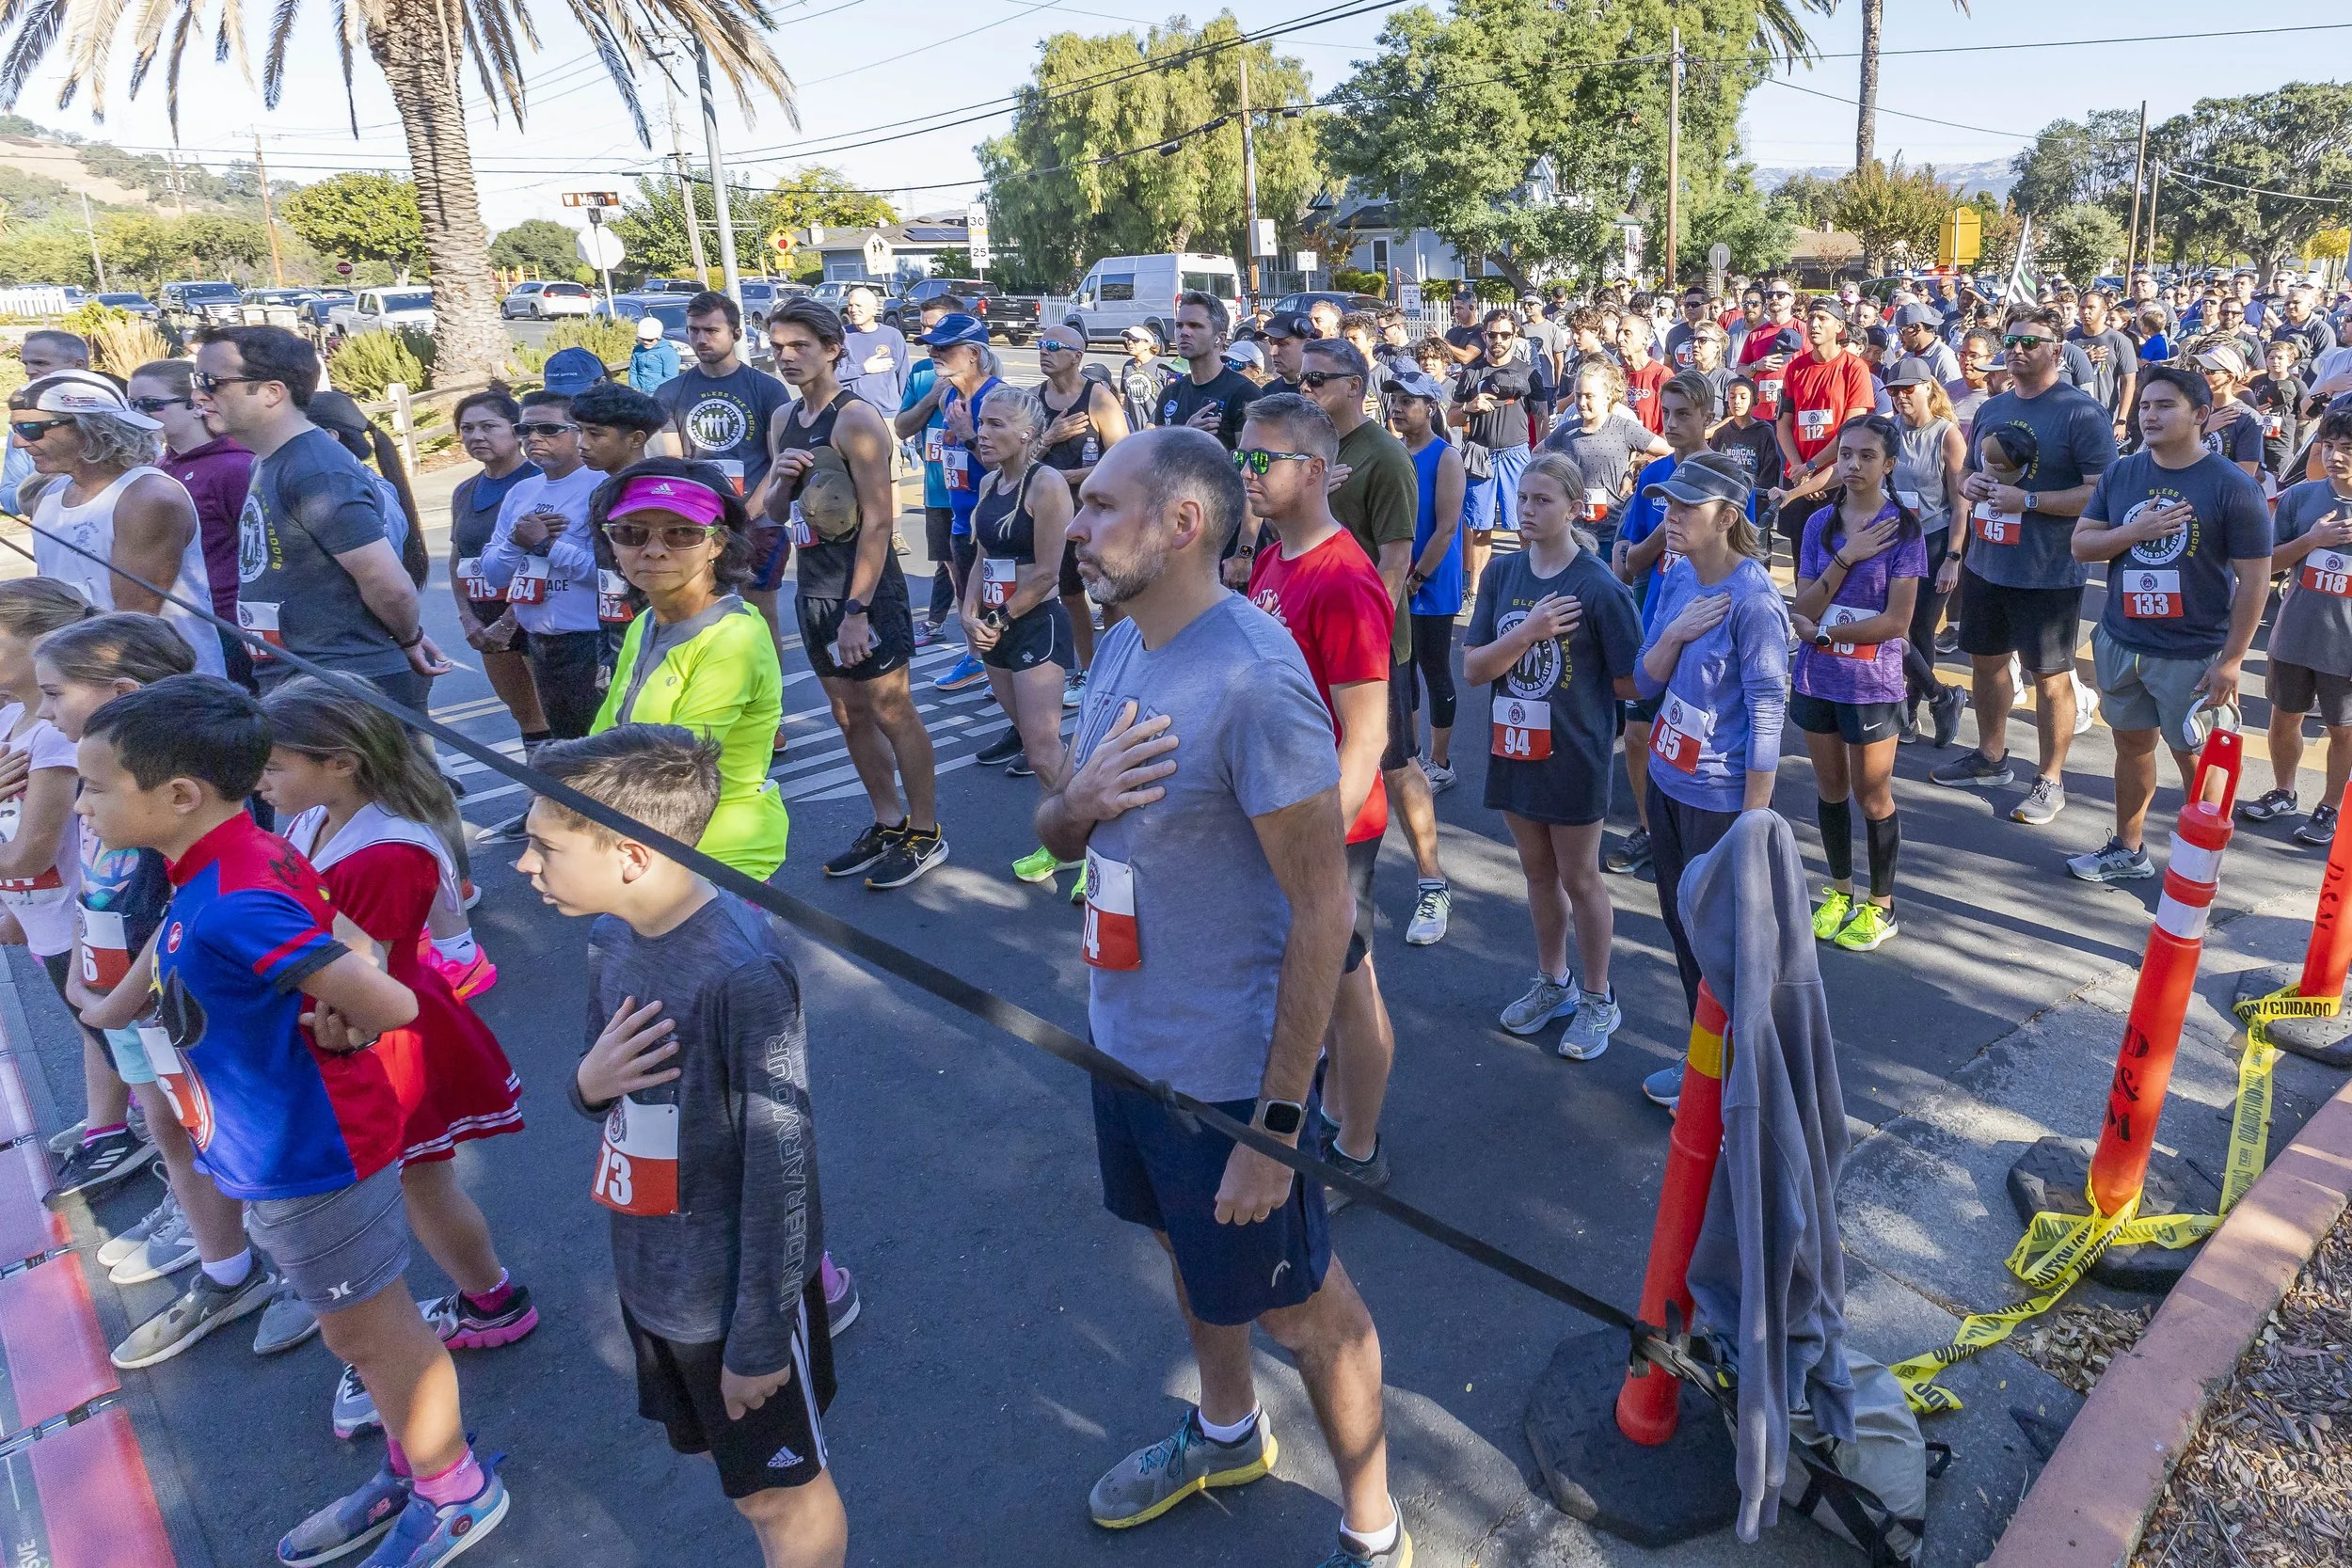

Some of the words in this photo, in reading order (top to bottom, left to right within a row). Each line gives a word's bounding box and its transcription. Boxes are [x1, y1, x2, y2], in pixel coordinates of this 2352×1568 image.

[563, 193, 574, 206] W
[577, 193, 607, 206] Main
[970, 216, 985, 227] 30
[972, 247, 987, 257] 25
[1805, 424, 1824, 439] 112
[1983, 520, 2005, 542] 45
[2149, 487, 2179, 498] BLESS
[2187, 516, 2200, 558] TROOPS
[546, 578, 570, 593] ACE
[2314, 570, 2348, 594] 118
[2133, 593, 2169, 616] 133
[1512, 598, 1535, 608] BLE
[1561, 639, 1573, 690] TROOPS
[1504, 726, 1531, 756] 94
[1656, 723, 1682, 761] 95
[2269, 1001, 2331, 1017] CUIDADO
[764, 1031, 806, 1184] ARMOUR
[780, 1186, 807, 1312] UNDER
[767, 1455, 804, 1468] adidas
